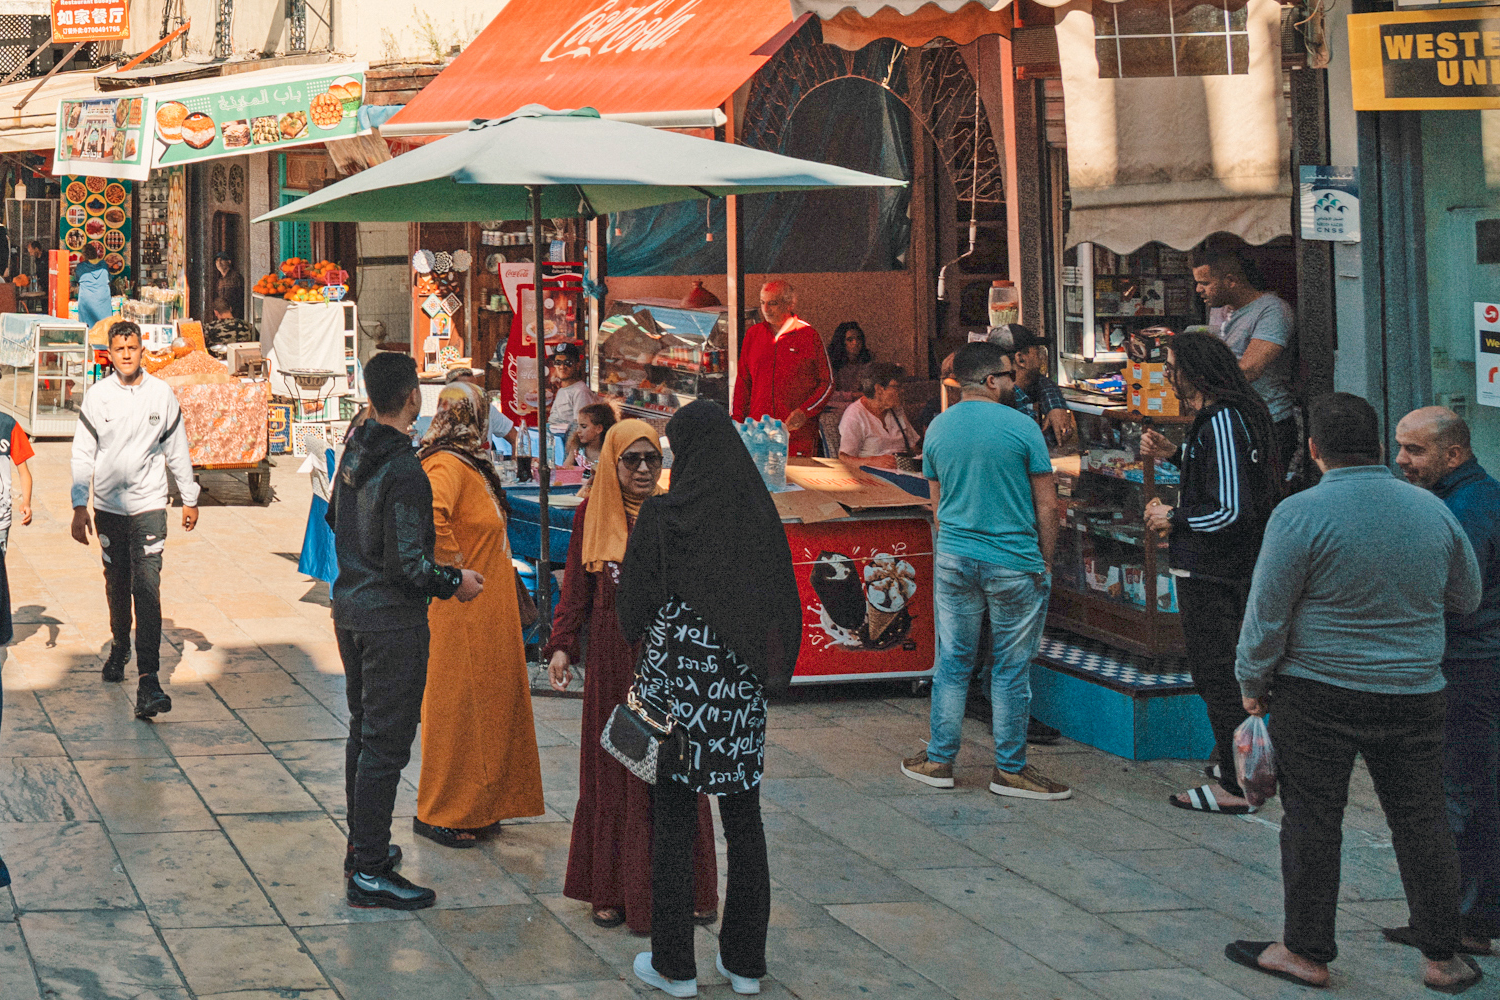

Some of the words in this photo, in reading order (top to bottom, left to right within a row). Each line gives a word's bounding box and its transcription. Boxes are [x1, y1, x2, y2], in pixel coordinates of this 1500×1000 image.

[56, 7, 125, 26] 如家餐厅
[505, 268, 529, 278] Coca-Cola
